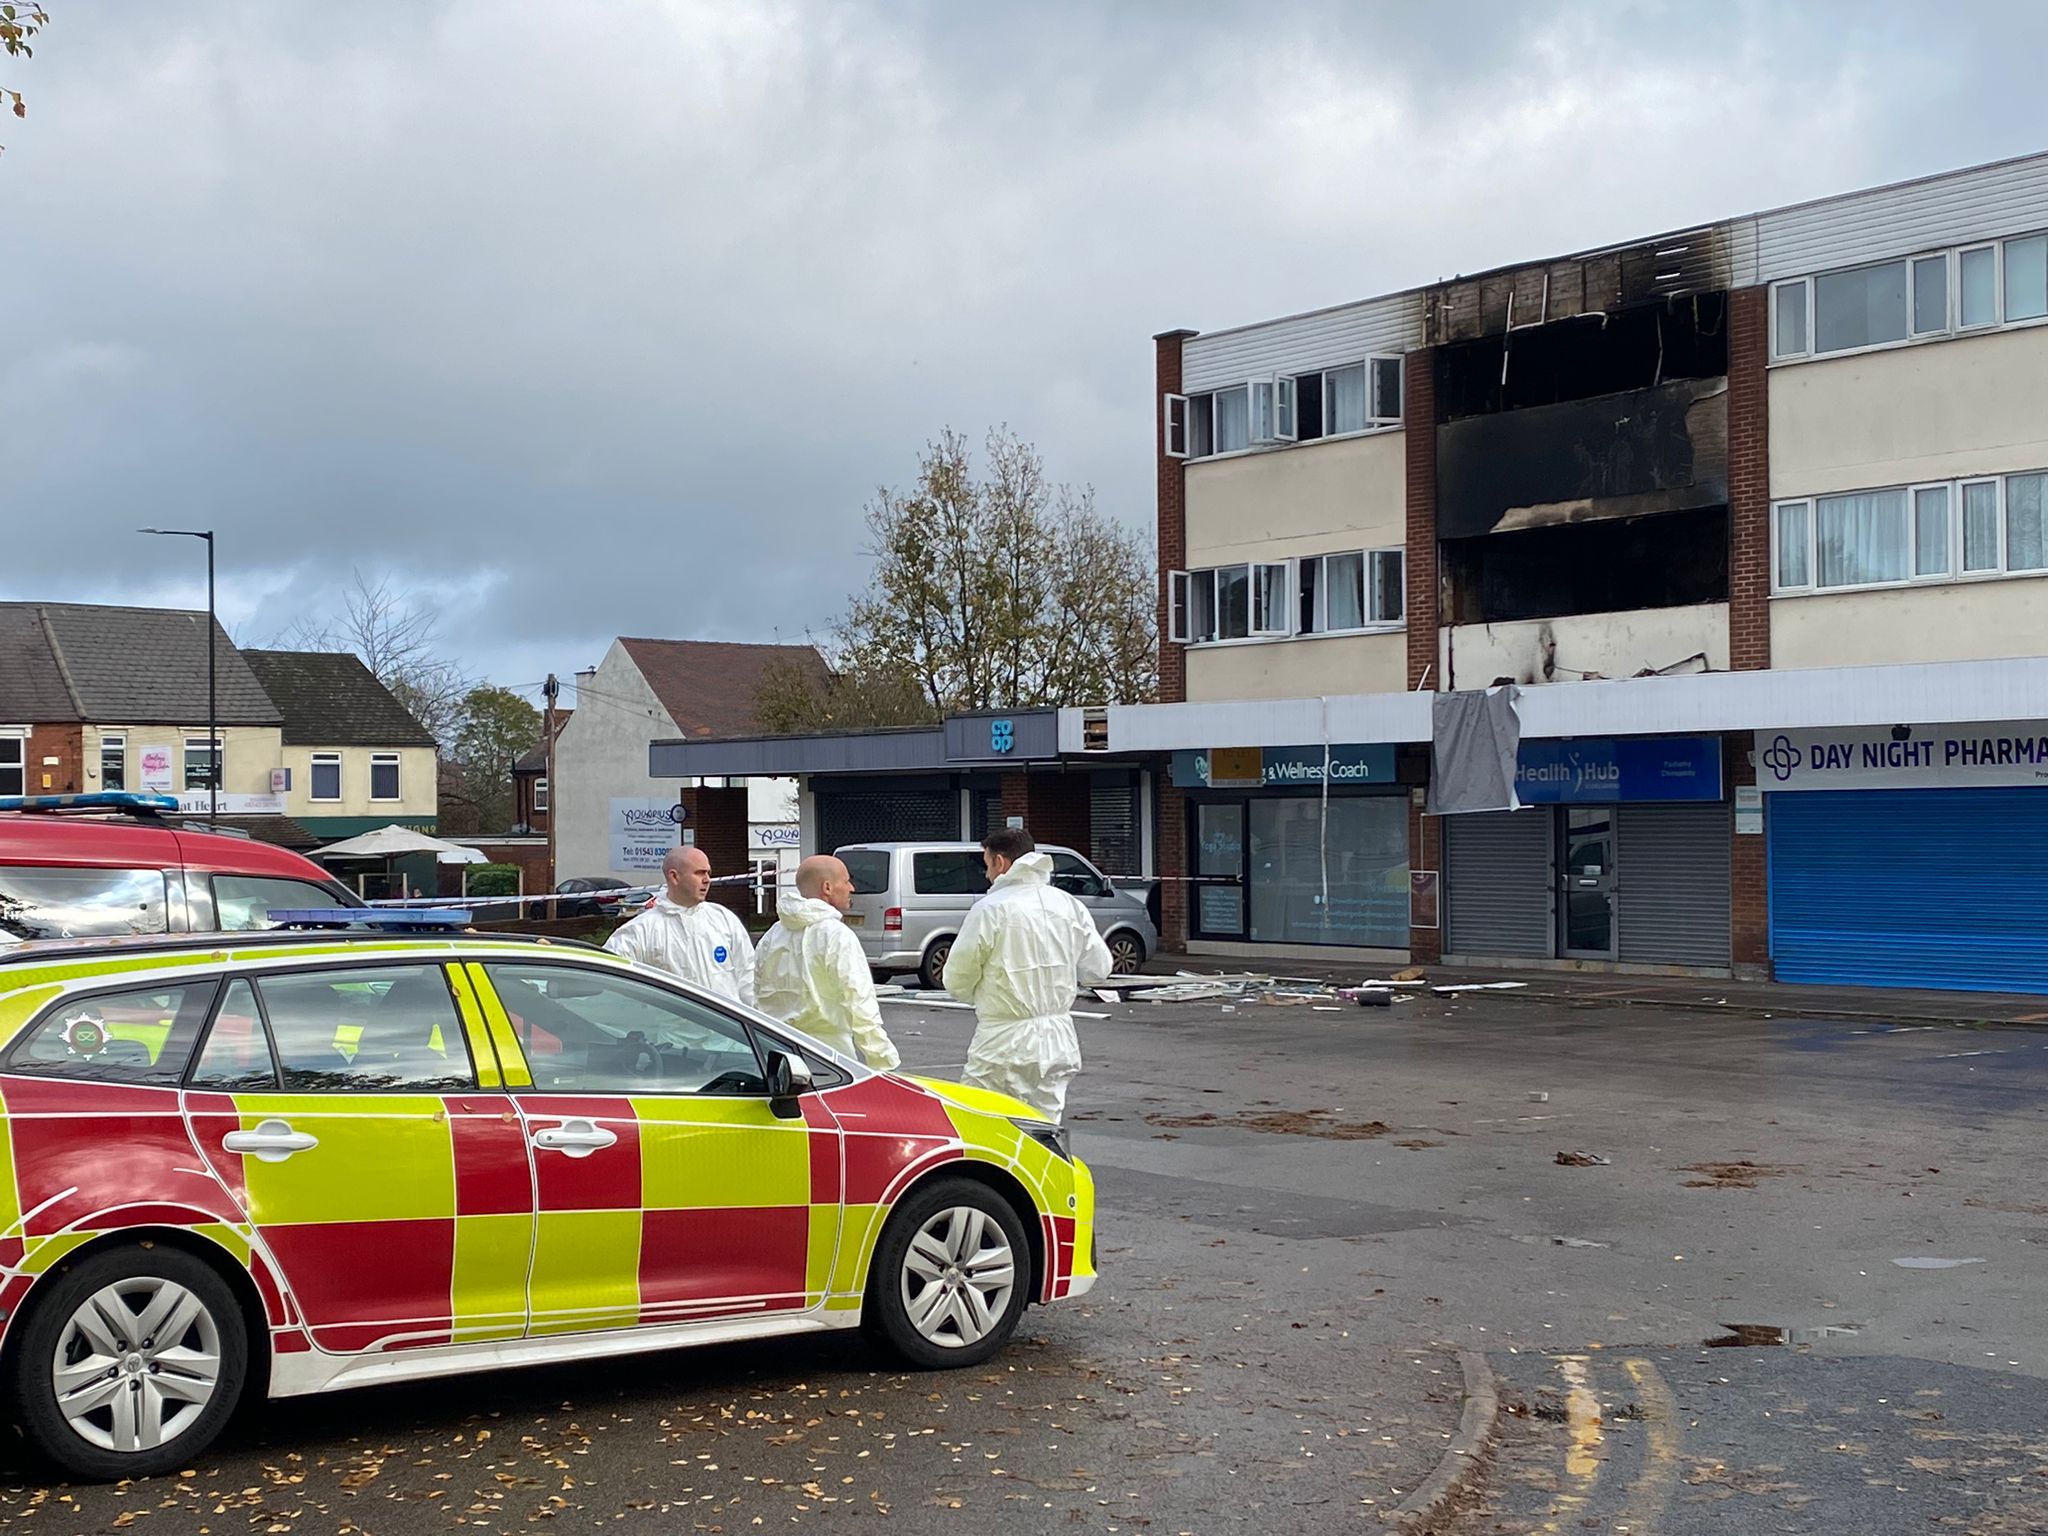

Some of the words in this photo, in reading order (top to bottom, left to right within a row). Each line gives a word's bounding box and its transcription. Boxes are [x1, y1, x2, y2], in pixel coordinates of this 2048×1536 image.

[1811, 743, 1853, 769] DAY
[1862, 741, 1934, 768] NIGHT
[1945, 737, 2048, 766] PHARMA
[1275, 762, 1327, 779] Wellness
[1330, 760, 1369, 778] Coach
[1516, 763, 1570, 781] Health
[1585, 761, 1620, 781] Hub
[195, 800, 228, 811] Hert
[621, 809, 673, 826] AQUARIUS
[61, 927, 73, 938] &
